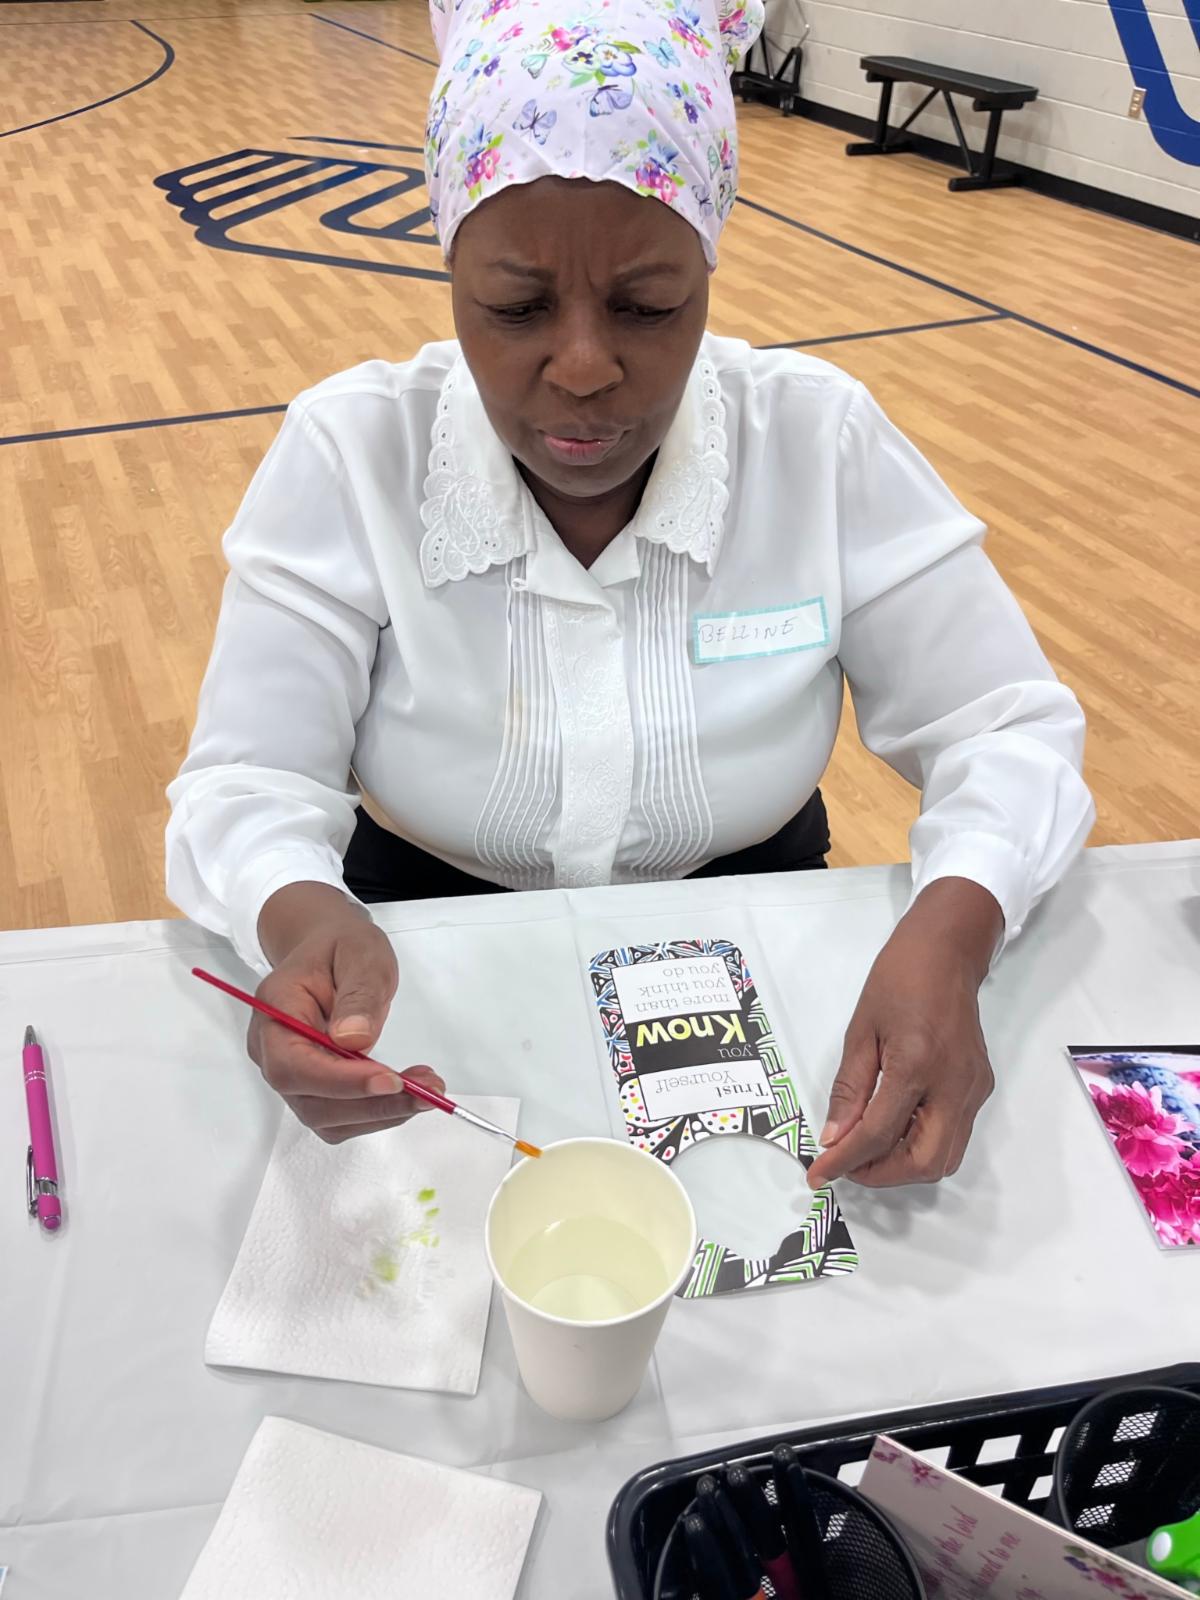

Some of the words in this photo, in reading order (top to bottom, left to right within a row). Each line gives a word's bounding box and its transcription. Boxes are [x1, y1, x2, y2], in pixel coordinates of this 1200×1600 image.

[662, 964, 685, 978] do
[689, 962, 720, 975] you
[638, 982, 689, 998] think
[694, 976, 727, 989] you
[635, 998, 679, 1013] than
[683, 993, 729, 1006] more
[636, 1013, 747, 1047] Know
[717, 1044, 754, 1059] you
[655, 1070, 737, 1094] Yourself
[715, 1082, 769, 1099] Trust
